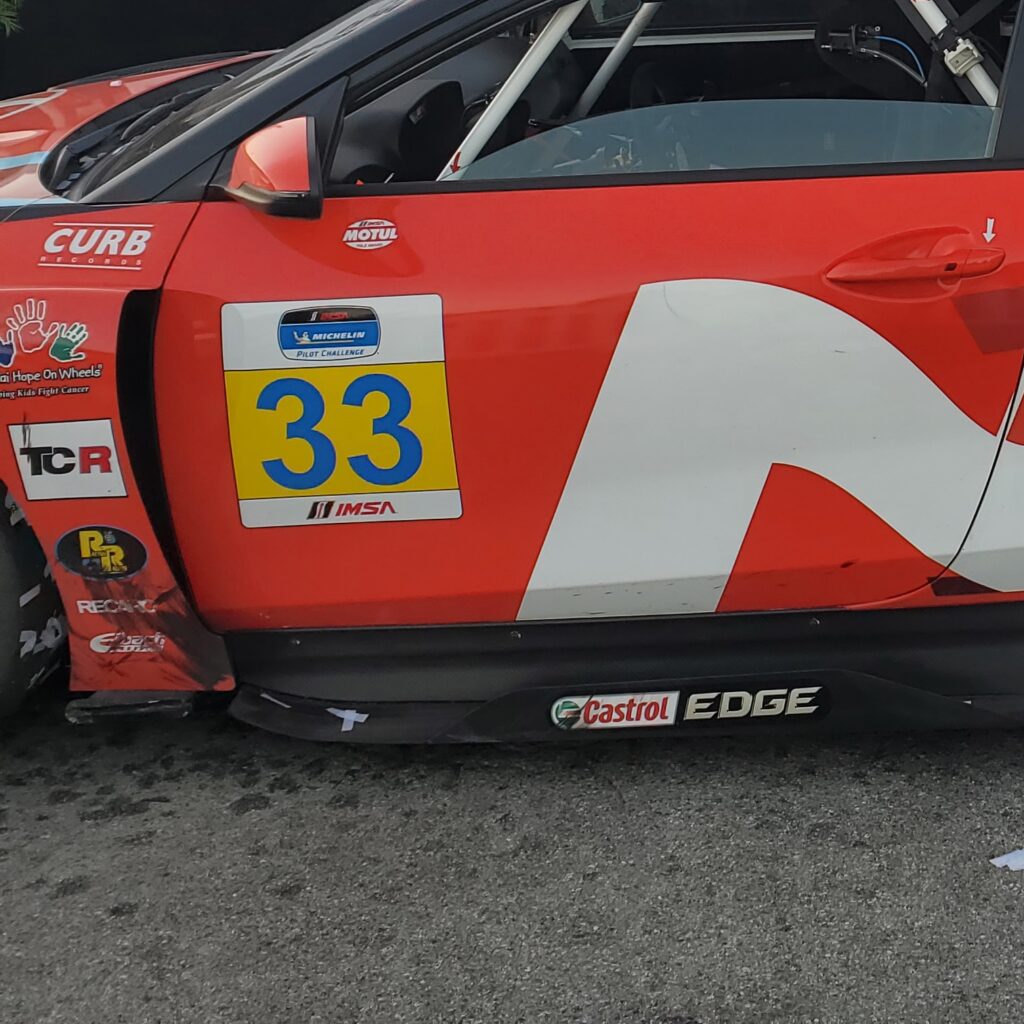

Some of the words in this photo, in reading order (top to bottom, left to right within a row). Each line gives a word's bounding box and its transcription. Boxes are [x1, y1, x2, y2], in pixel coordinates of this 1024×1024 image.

[44, 228, 152, 256] CURB
[342, 228, 398, 241] MOTUL
[312, 331, 366, 341] MICHELIN
[12, 370, 41, 384] Hope
[43, 369, 58, 379] On
[256, 373, 423, 490] 33
[19, 444, 113, 475] TCR
[335, 501, 397, 517] IMSA
[582, 695, 669, 725] Castrol
[683, 686, 823, 721] EDGE
